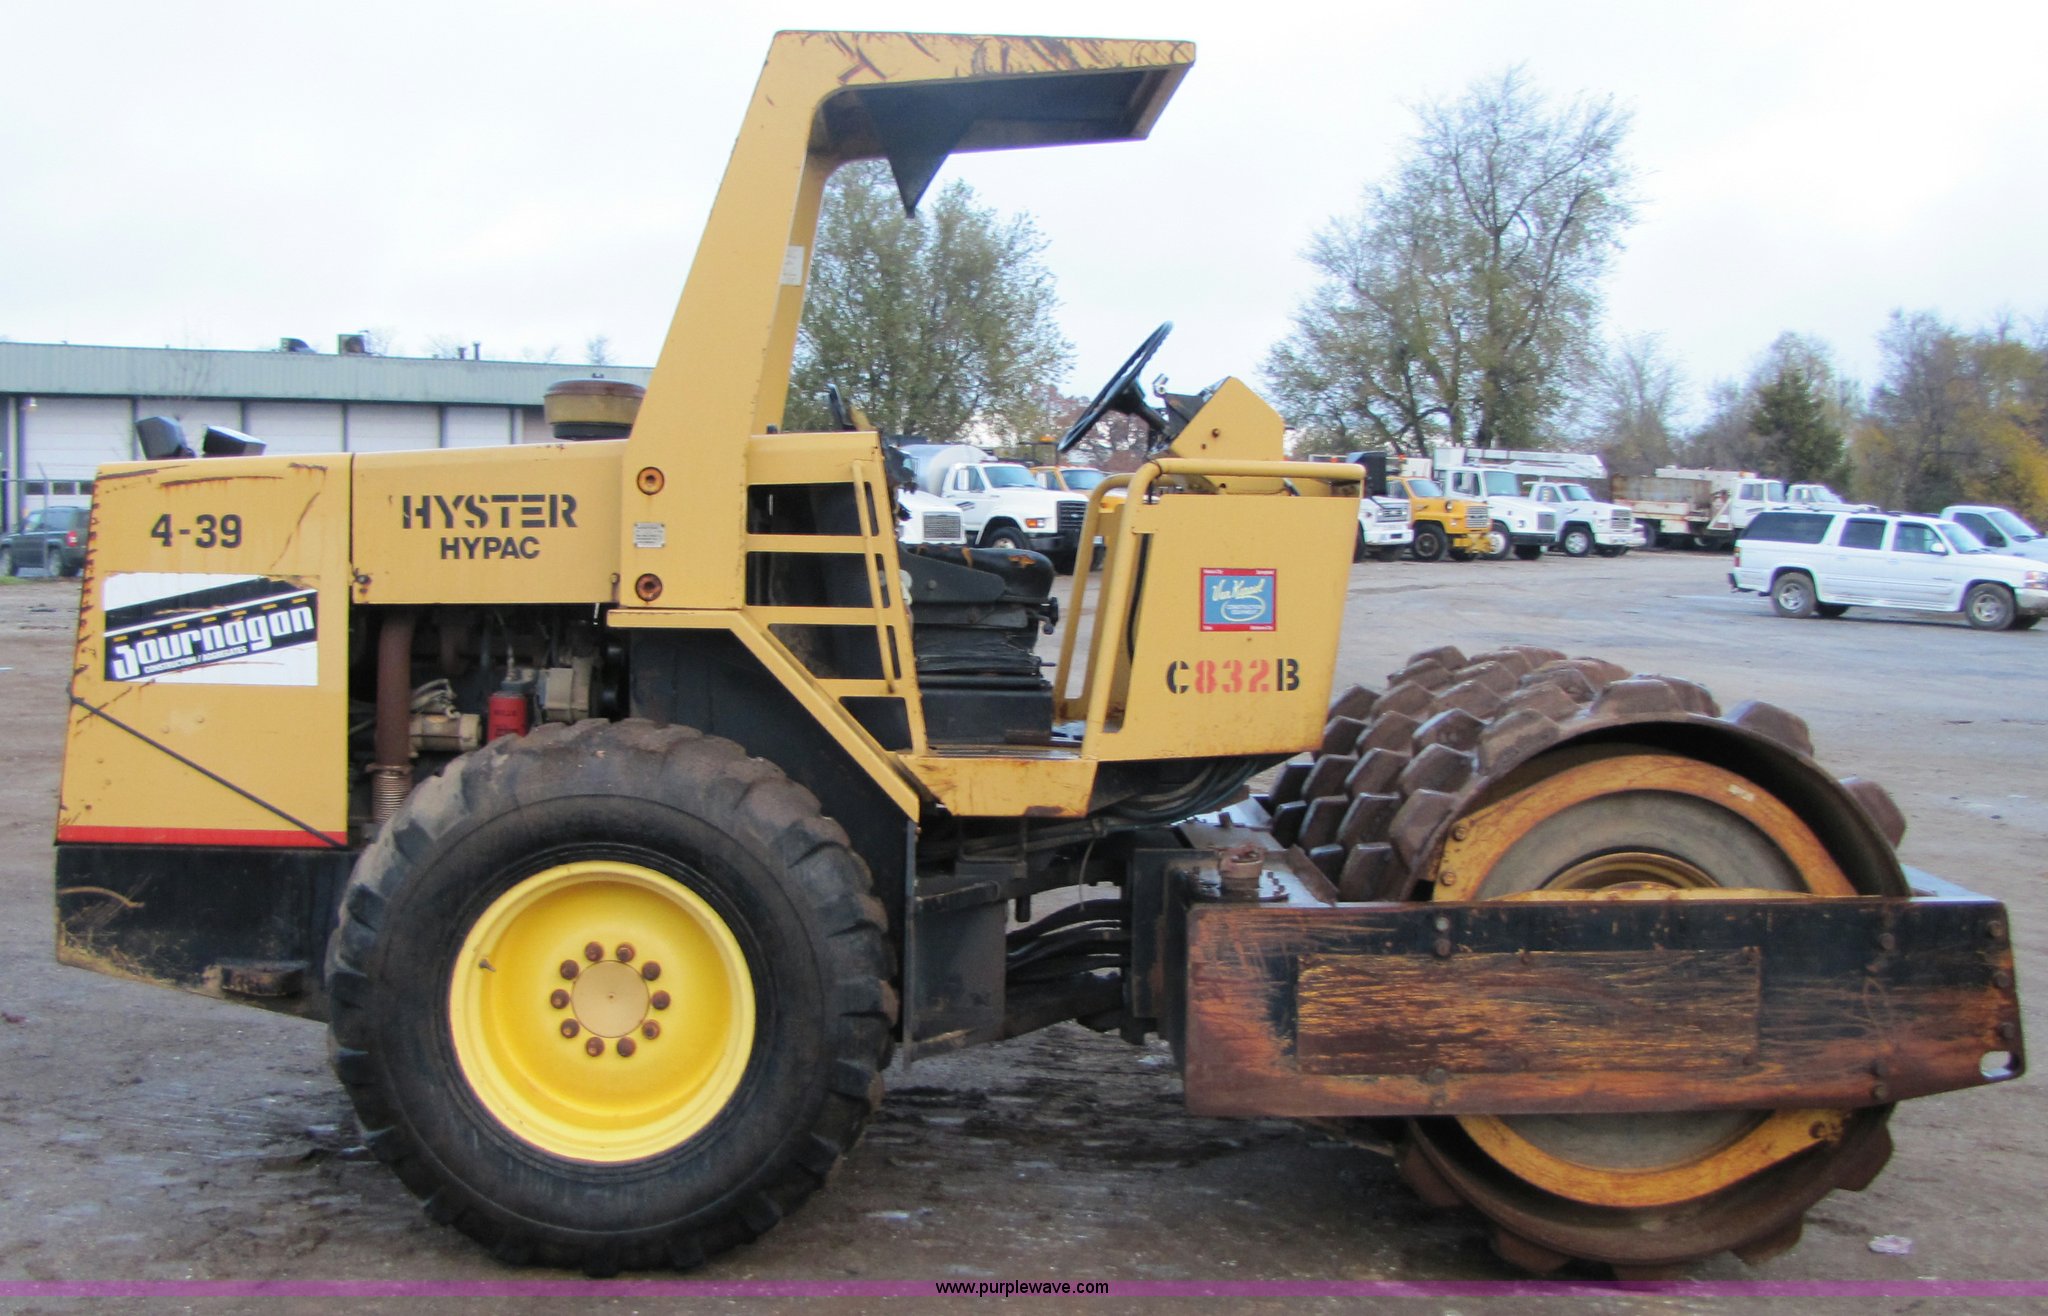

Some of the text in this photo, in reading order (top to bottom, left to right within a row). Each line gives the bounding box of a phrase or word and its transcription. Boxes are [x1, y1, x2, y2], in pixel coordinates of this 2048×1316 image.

[402, 494, 578, 529] HYSTER
[151, 513, 242, 548] 4-39
[440, 536, 541, 560] HYPAC
[1166, 658, 1300, 694] C832B
